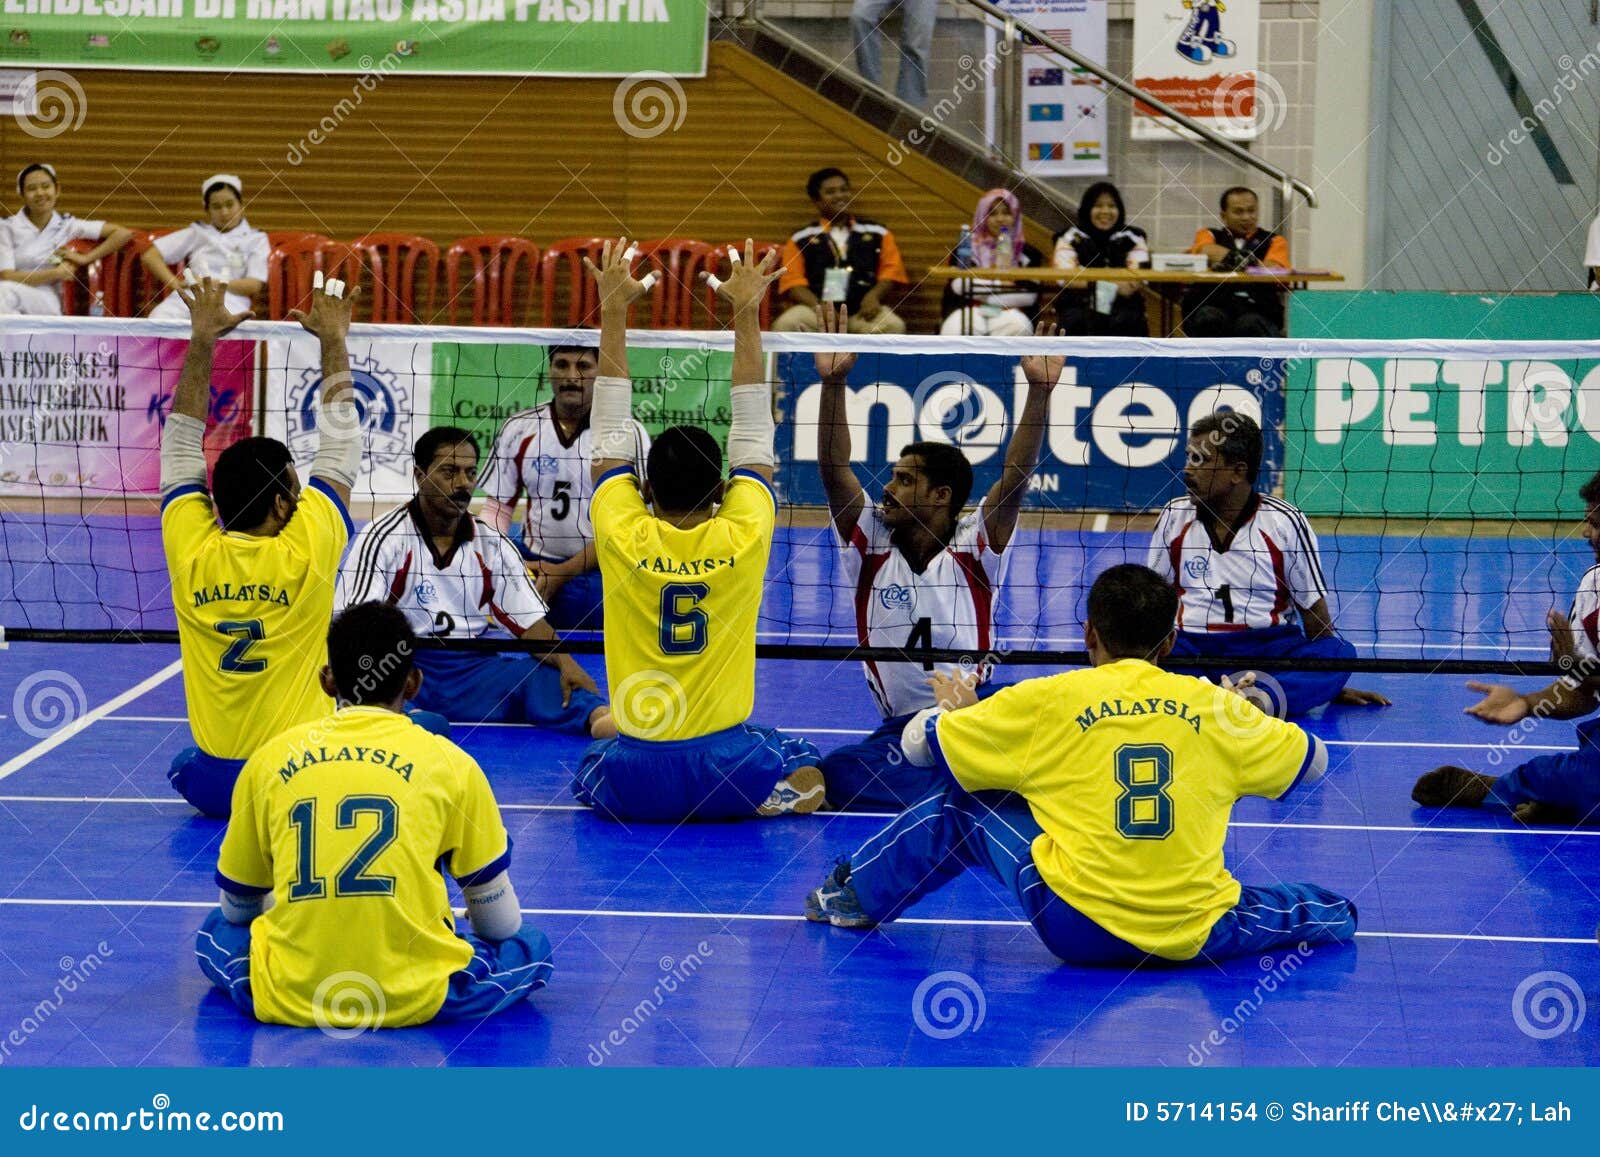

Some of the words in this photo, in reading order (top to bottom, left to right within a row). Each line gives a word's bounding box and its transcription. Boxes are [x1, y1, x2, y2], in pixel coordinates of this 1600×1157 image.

[550, 480, 572, 521] 5
[193, 583, 290, 608] MALAYSIA
[1214, 584, 1234, 624] 1
[658, 581, 711, 656] 6
[214, 617, 268, 673] 2
[1075, 698, 1201, 735] MALAYSIA
[278, 746, 415, 785] MALAYSIA
[1114, 742, 1175, 841] 8
[287, 793, 400, 903] 12
